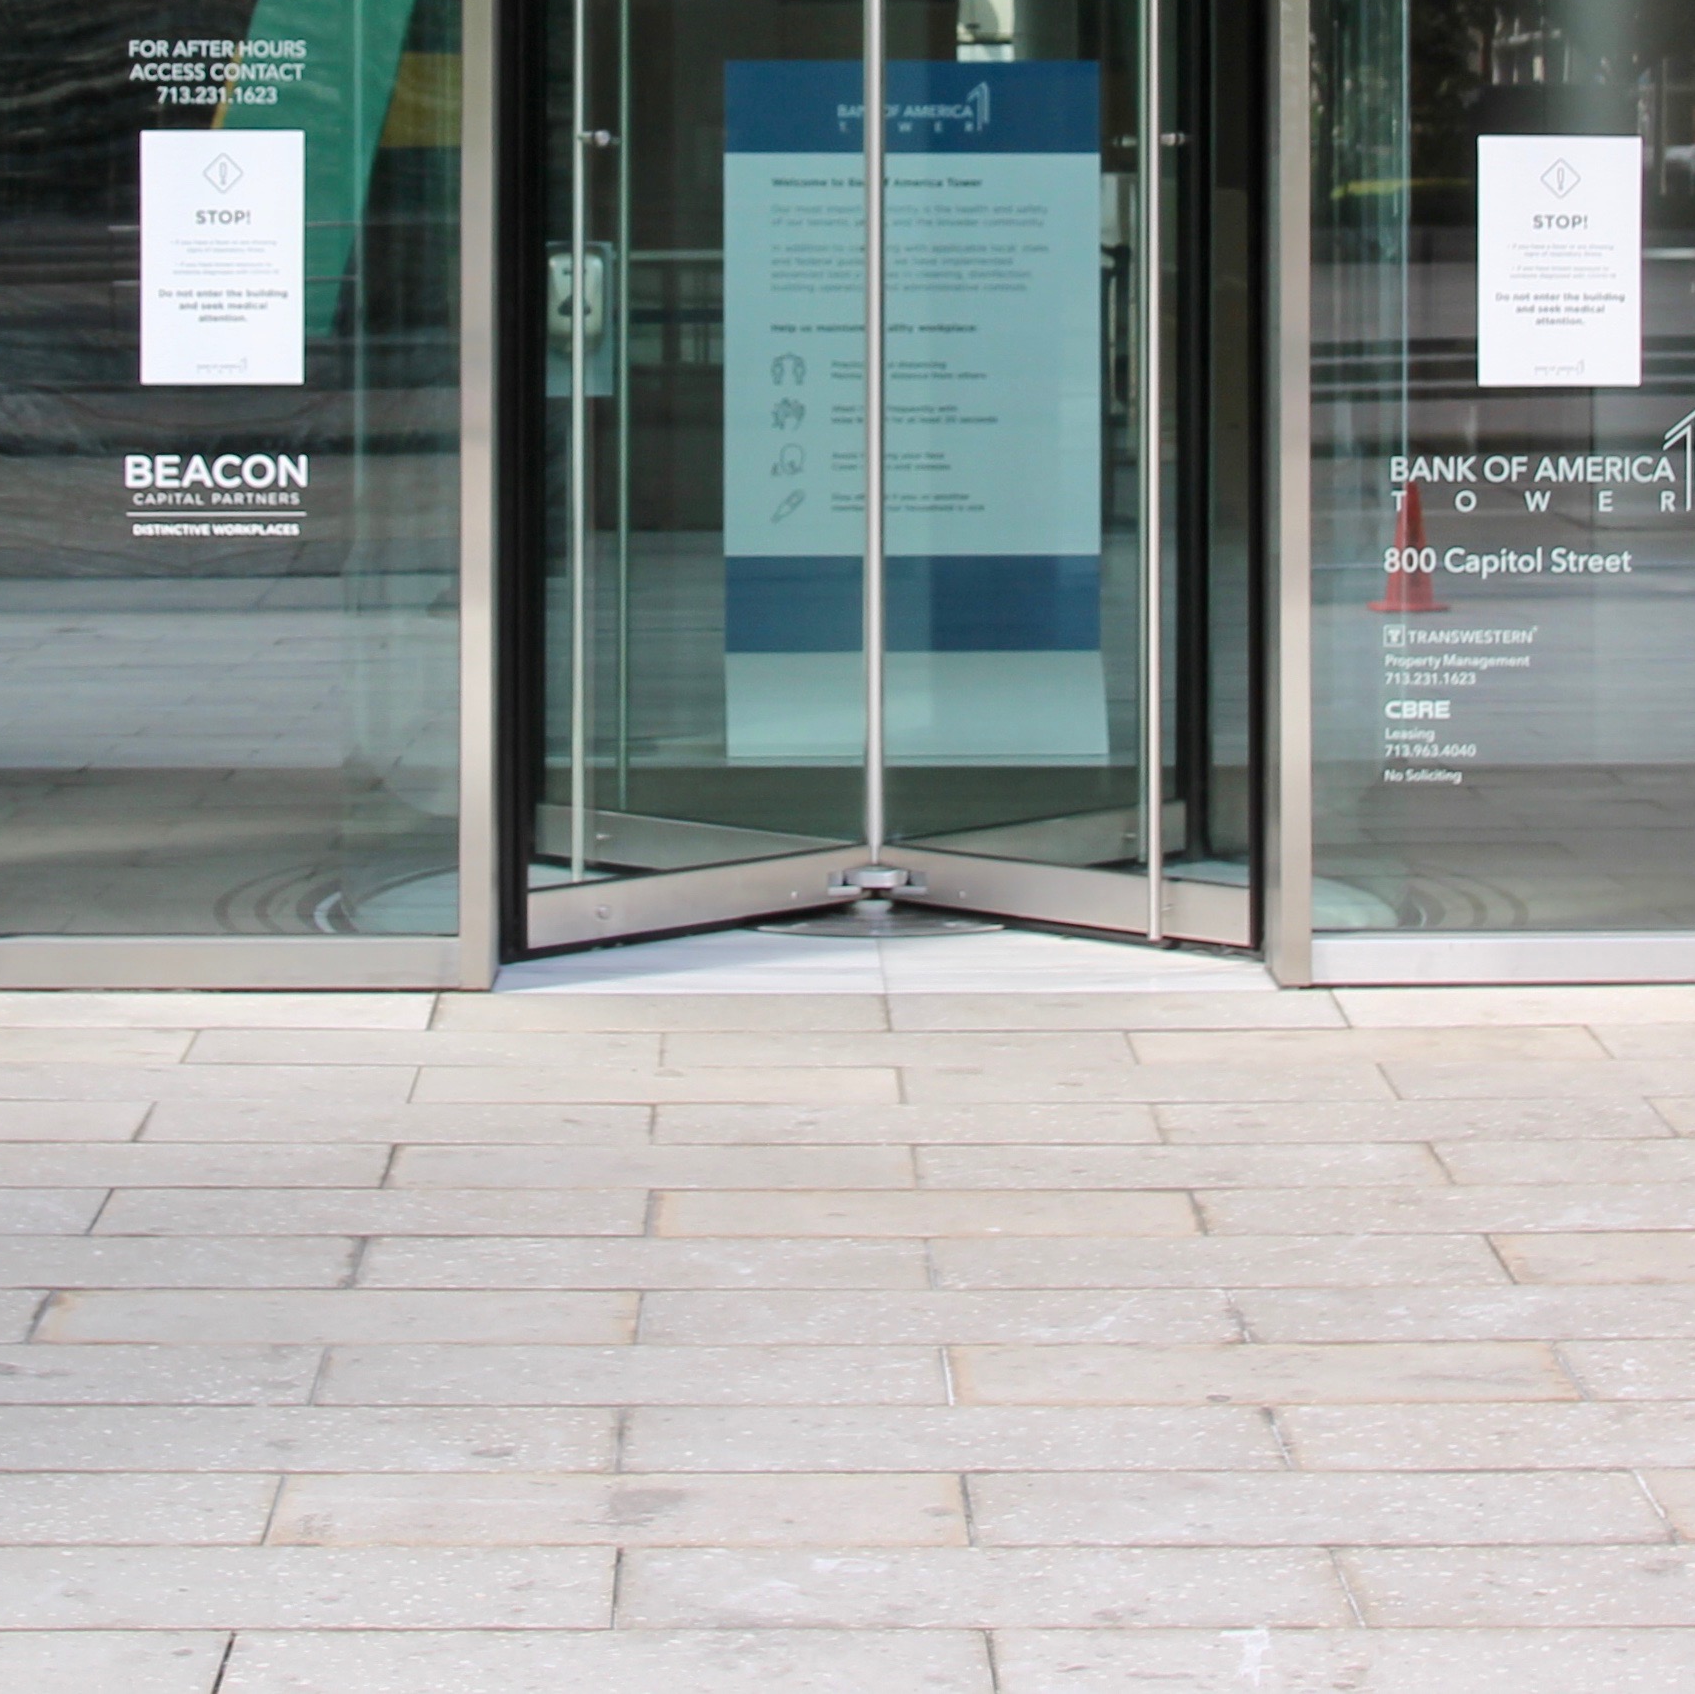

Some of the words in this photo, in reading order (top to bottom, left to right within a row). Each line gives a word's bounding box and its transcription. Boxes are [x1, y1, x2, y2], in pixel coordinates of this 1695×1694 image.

[128, 40, 168, 58] FOR
[172, 40, 234, 58] AFTER
[238, 40, 306, 58] HOURS
[129, 63, 205, 81] ACCESS
[209, 63, 305, 81] CONTACT
[157, 86, 278, 104] 713.231.1623
[195, 210, 251, 225] STOP!
[1533, 214, 1588, 230] STOP!
[124, 454, 308, 488] BEACON
[1390, 456, 1477, 482] BANK
[1484, 456, 1528, 482] OF
[1534, 456, 1675, 482] AMERICA
[133, 493, 204, 505] CAPITAL
[212, 493, 300, 505] PARTNERS
[1392, 491, 1675, 512] TOWER
[132, 524, 210, 536] DISTINCTIVE
[212, 524, 300, 536] WORKPLACES
[1383, 547, 1436, 574] 800
[1444, 547, 1543, 579] Capitol
[1550, 547, 1631, 574] Street
[1385, 654, 1440, 669] Property
[1443, 654, 1530, 669] Management
[1385, 672, 1476, 685] 713.231.1623
[1385, 700, 1451, 719] CBRE
[1385, 728, 1435, 744] Leasing
[1385, 745, 1477, 757] 713.963.4040
[1384, 769, 1403, 782] No
[1406, 769, 1462, 784] Soliciting
